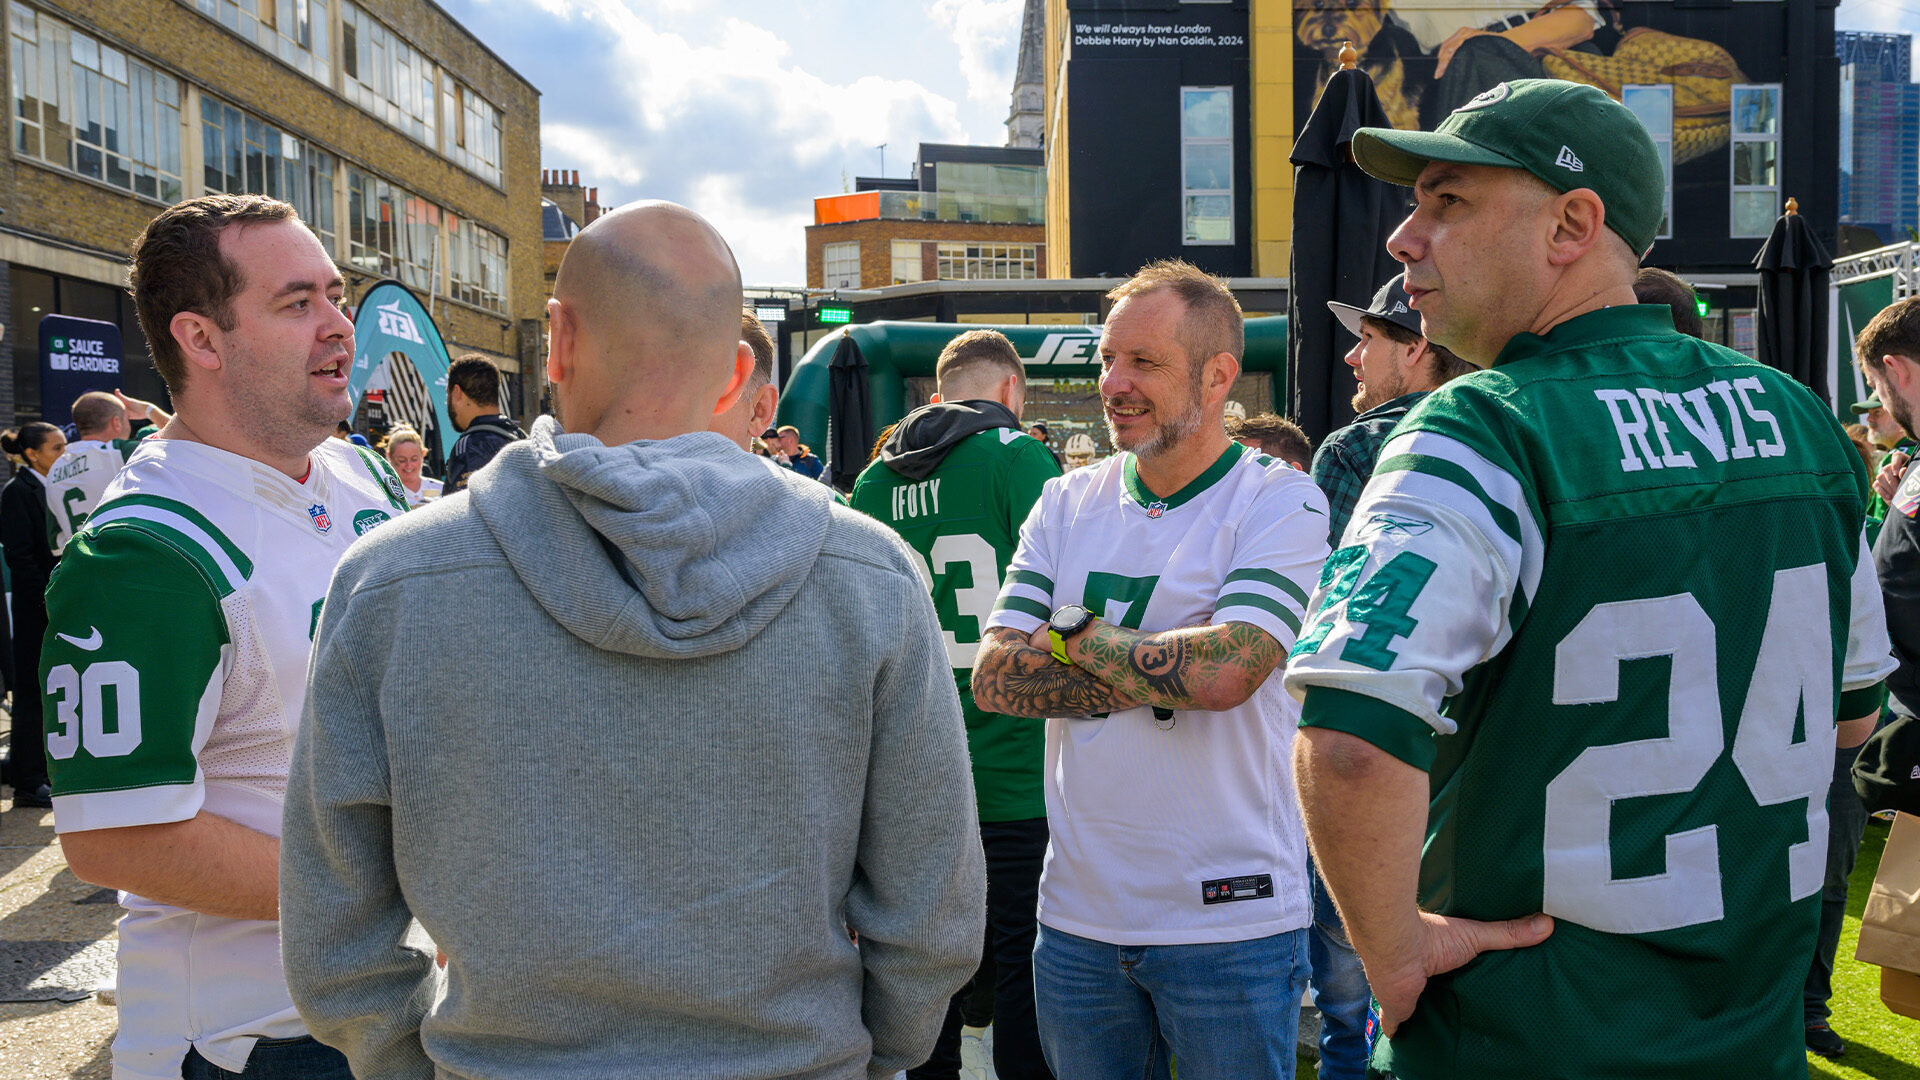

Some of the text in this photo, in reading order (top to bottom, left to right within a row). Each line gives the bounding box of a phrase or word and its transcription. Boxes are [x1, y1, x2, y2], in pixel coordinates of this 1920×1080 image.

[1075, 24, 1211, 35] We will always have London
[1075, 36, 1243, 48] Debbie Harry by Nan Goldin, 2024
[68, 338, 104, 356] SAUCE
[69, 356, 120, 374] GARDNER
[1595, 376, 1787, 473] REVIS
[891, 478, 941, 521] IFOTY
[314, 514, 331, 529] NFL
[1289, 544, 1438, 671] 24
[46, 660, 143, 760] 30
[1542, 561, 1838, 935] 24
